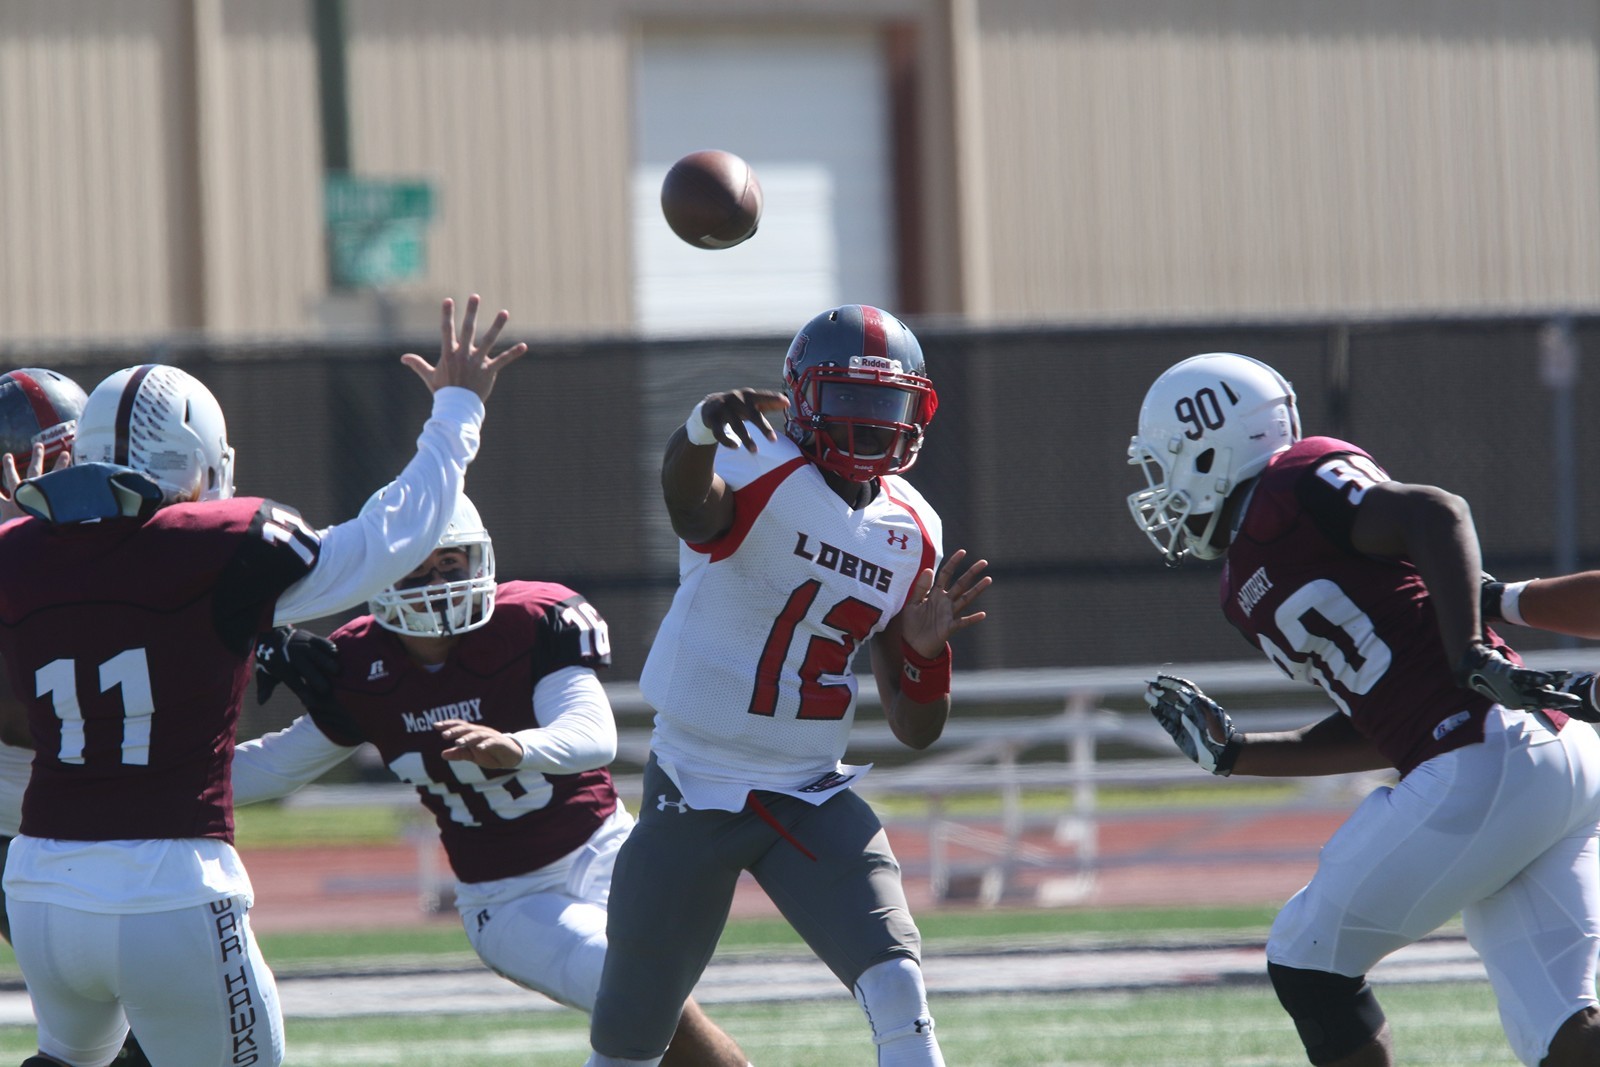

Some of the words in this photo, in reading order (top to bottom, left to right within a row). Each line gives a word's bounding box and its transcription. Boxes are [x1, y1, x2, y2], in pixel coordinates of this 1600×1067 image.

[862, 359, 891, 369] Riddell
[1175, 387, 1226, 441] 90
[262, 507, 321, 569] 11
[793, 531, 894, 594] LOBOS
[561, 602, 611, 657] 16
[747, 578, 883, 720] 12
[35, 647, 155, 766] 11
[401, 698, 483, 733] McMURRY
[388, 751, 554, 827] 16
[210, 898, 242, 963] WAR
[224, 966, 259, 1067] HAWKS
